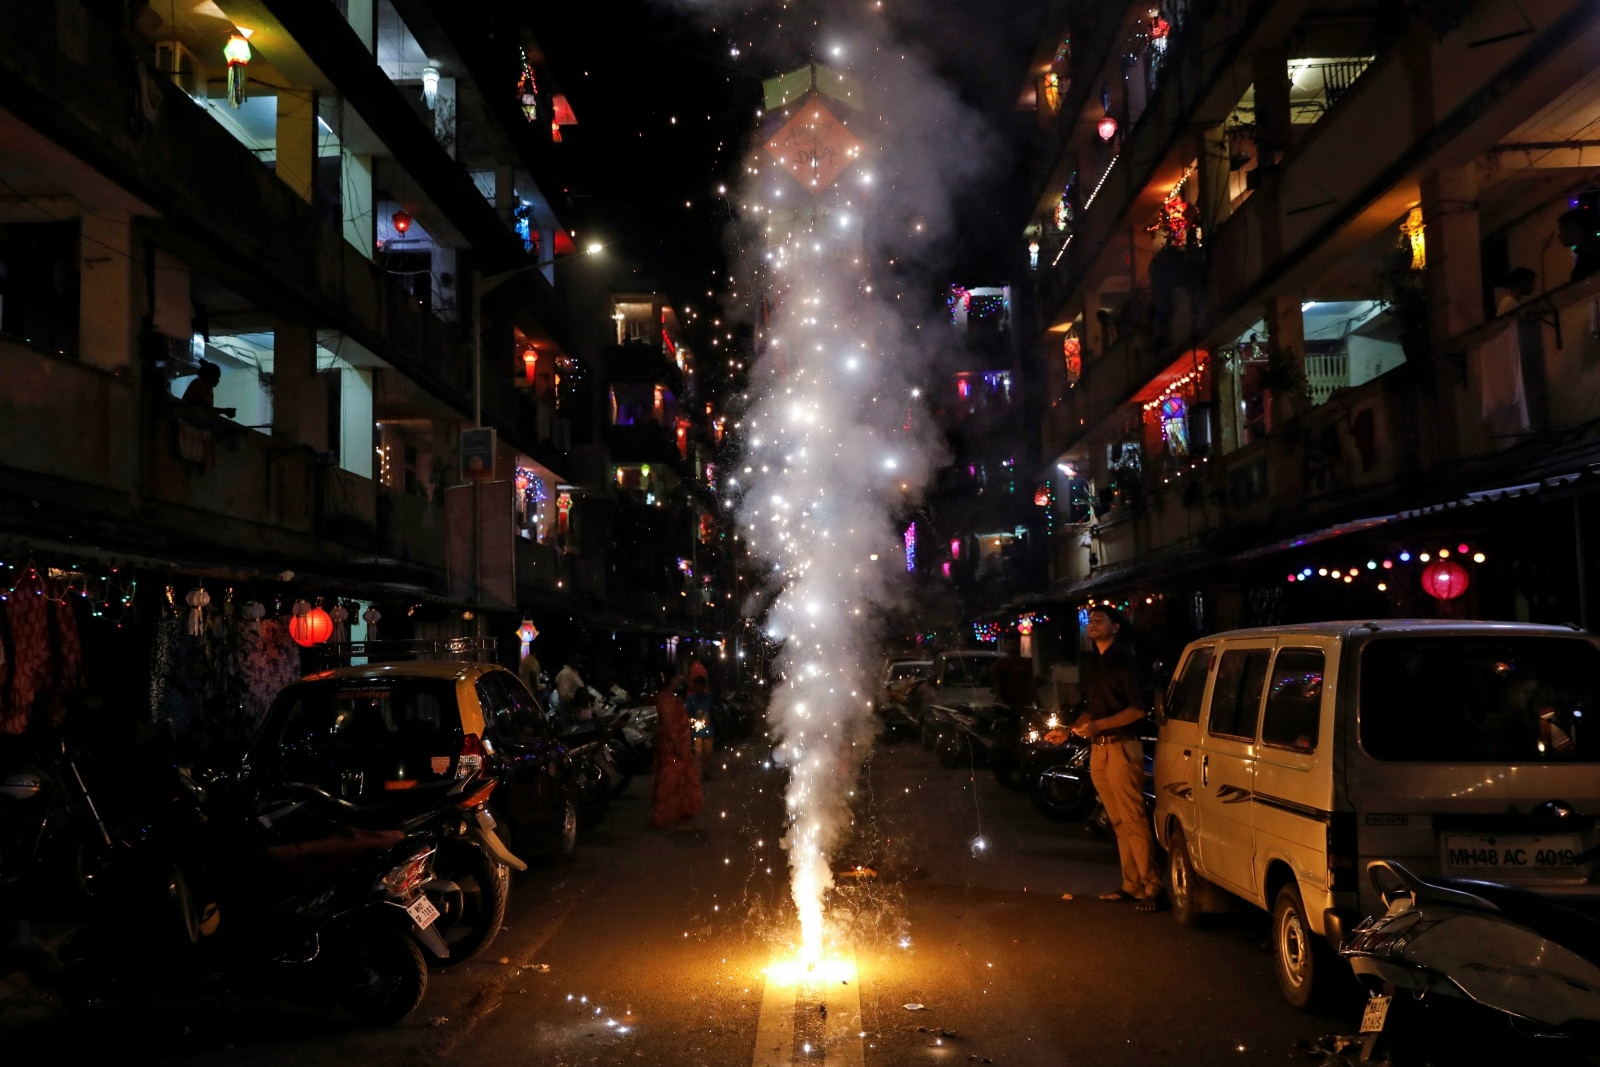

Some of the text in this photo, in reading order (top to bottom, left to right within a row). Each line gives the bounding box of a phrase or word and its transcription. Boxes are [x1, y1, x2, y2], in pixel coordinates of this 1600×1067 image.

[1450, 849, 1574, 866] MH48 AC 4019
